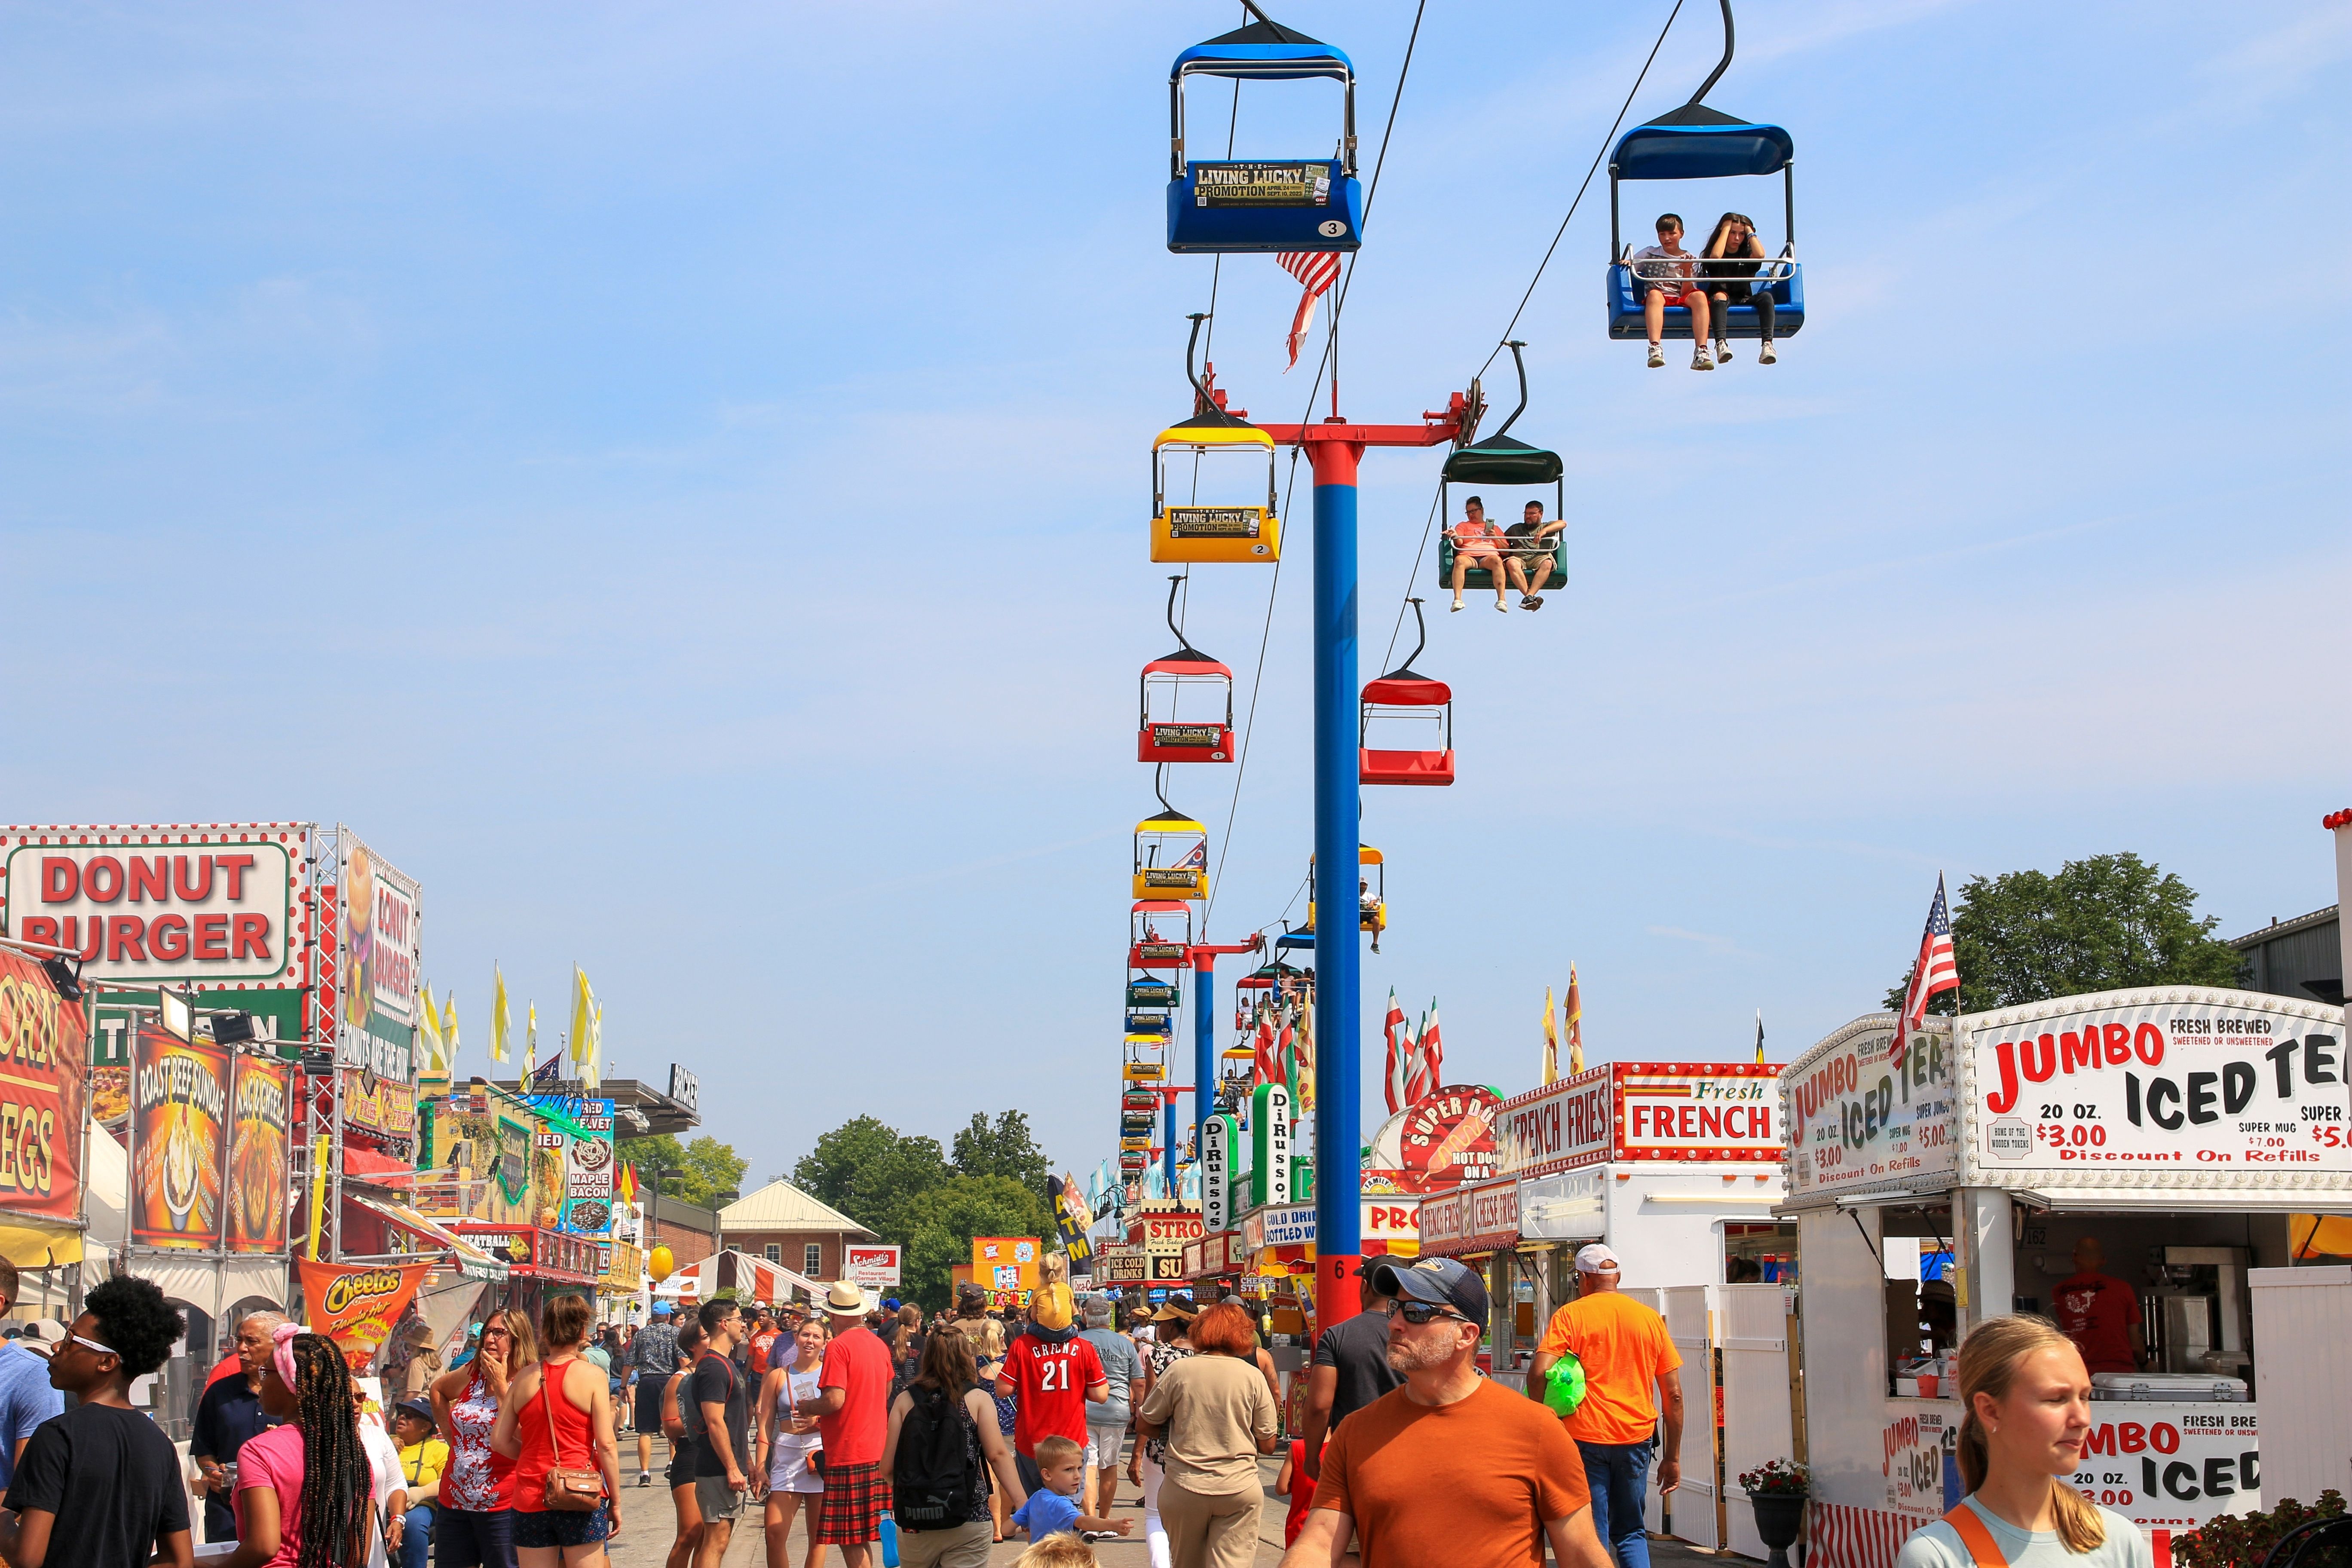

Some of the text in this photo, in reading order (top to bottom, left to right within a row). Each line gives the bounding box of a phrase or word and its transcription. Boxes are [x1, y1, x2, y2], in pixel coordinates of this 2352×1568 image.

[1198, 169, 1302, 184] LIVING LUCKY
[1199, 186, 1265, 197] PROMOTION
[1328, 223, 1337, 235] 3
[1173, 513, 1241, 523] LIVING LUCKY
[41, 854, 254, 903] DONUT
[379, 887, 408, 946] DONUT
[21, 913, 272, 963] BURGER
[375, 939, 410, 1000] BURGER
[2170, 1019, 2272, 1035] FRESH BREWED
[1857, 1038, 1874, 1057] FRESH
[2173, 1036, 2274, 1047] SWEETENED OR UNSWEETENED
[344, 1020, 409, 1084] DONUTS ARE THE BUN
[1986, 1022, 2164, 1115] JUMBO
[140, 1055, 226, 1127] ROAST BEEF SUNDAE
[673, 1064, 699, 1111] BRICKER
[1692, 1081, 1764, 1101] Fresh
[1841, 1034, 1946, 1150] ICED TEA
[2125, 1061, 2257, 1130] ICED
[236, 1076, 285, 1128] MAC & CHEESE
[582, 1103, 603, 1114] RED
[1792, 1053, 1858, 1148] JUMBO
[1916, 1103, 1932, 1121] SUPER
[2040, 1104, 2101, 1119] 20 OZ.
[2301, 1106, 2342, 1121] SUPER
[1410, 1096, 1463, 1147] SUPER
[1513, 1101, 1561, 1160] FRENCH
[1568, 1082, 1606, 1148] FRIES
[1632, 1106, 1771, 1139] FRENCH
[2239, 1122, 2297, 1133] SUPER MUG
[1816, 1124, 1839, 1142] 20 OZ.
[1889, 1124, 1911, 1140] SUPER MUG
[1918, 1124, 1946, 1149] $5.00
[1994, 1127, 2025, 1136] HOME OF THE
[2036, 1123, 2107, 1148] $3.00
[1991, 1139, 2029, 1148] WOODEN TOKENS
[2248, 1137, 2285, 1148] $7.00
[1452, 1152, 1475, 1164] HOT
[1814, 1144, 1842, 1169] $3.00
[2060, 1149, 2321, 1162] Discount On Refills
[571, 1174, 609, 1184] MAPLE
[1205, 1122, 1222, 1226] DiRusso's
[1464, 1166, 1490, 1179] ON A
[1819, 1158, 1921, 1184] Discount On Refills
[145, 1173, 159, 1204] GRAVY
[1364, 1177, 1389, 1188] FAMILY
[570, 1187, 609, 1197] BACON
[1475, 1195, 1498, 1228] CHEESE
[1500, 1191, 1517, 1225] FRIES
[1267, 1211, 1287, 1226] COLD
[1424, 1205, 1443, 1237] FRENCH
[1445, 1202, 1459, 1234] FRIES
[1055, 1194, 1090, 1262] ATM
[1266, 1227, 1302, 1243] BOTTLED
[460, 1234, 510, 1247] MEATBALL
[2027, 1230, 2046, 1245] 162
[851, 1251, 889, 1269] Schmidt's
[1111, 1258, 1145, 1268] ICE COLD
[1159, 1259, 1182, 1277] SU
[996, 1269, 1018, 1285] ICEE
[1113, 1268, 1142, 1279] DRINKS
[1334, 1260, 1344, 1279] 6
[326, 1268, 401, 1313] Cheetos
[352, 1295, 379, 1306] Crunchy
[328, 1301, 391, 1335] Flamin' Hot
[362, 1330, 379, 1338] FOOD
[374, 1324, 387, 1338] FAIR
[1032, 1341, 1079, 1359] GREENE
[1041, 1359, 1069, 1391] 21
[1919, 1413, 1942, 1426] FRESH BREWED
[2183, 1415, 2257, 1427] FRESH BRE
[1882, 1416, 1919, 1477] JUMBO
[1898, 1466, 1902, 1477] 20
[1910, 1445, 1939, 1492] ICED
[2074, 1473, 2128, 1485] 20 OZ.
[1898, 1481, 1912, 1498] $3.00
[904, 1506, 944, 1520] PUMA
[1898, 1502, 1935, 1515] Discount On
